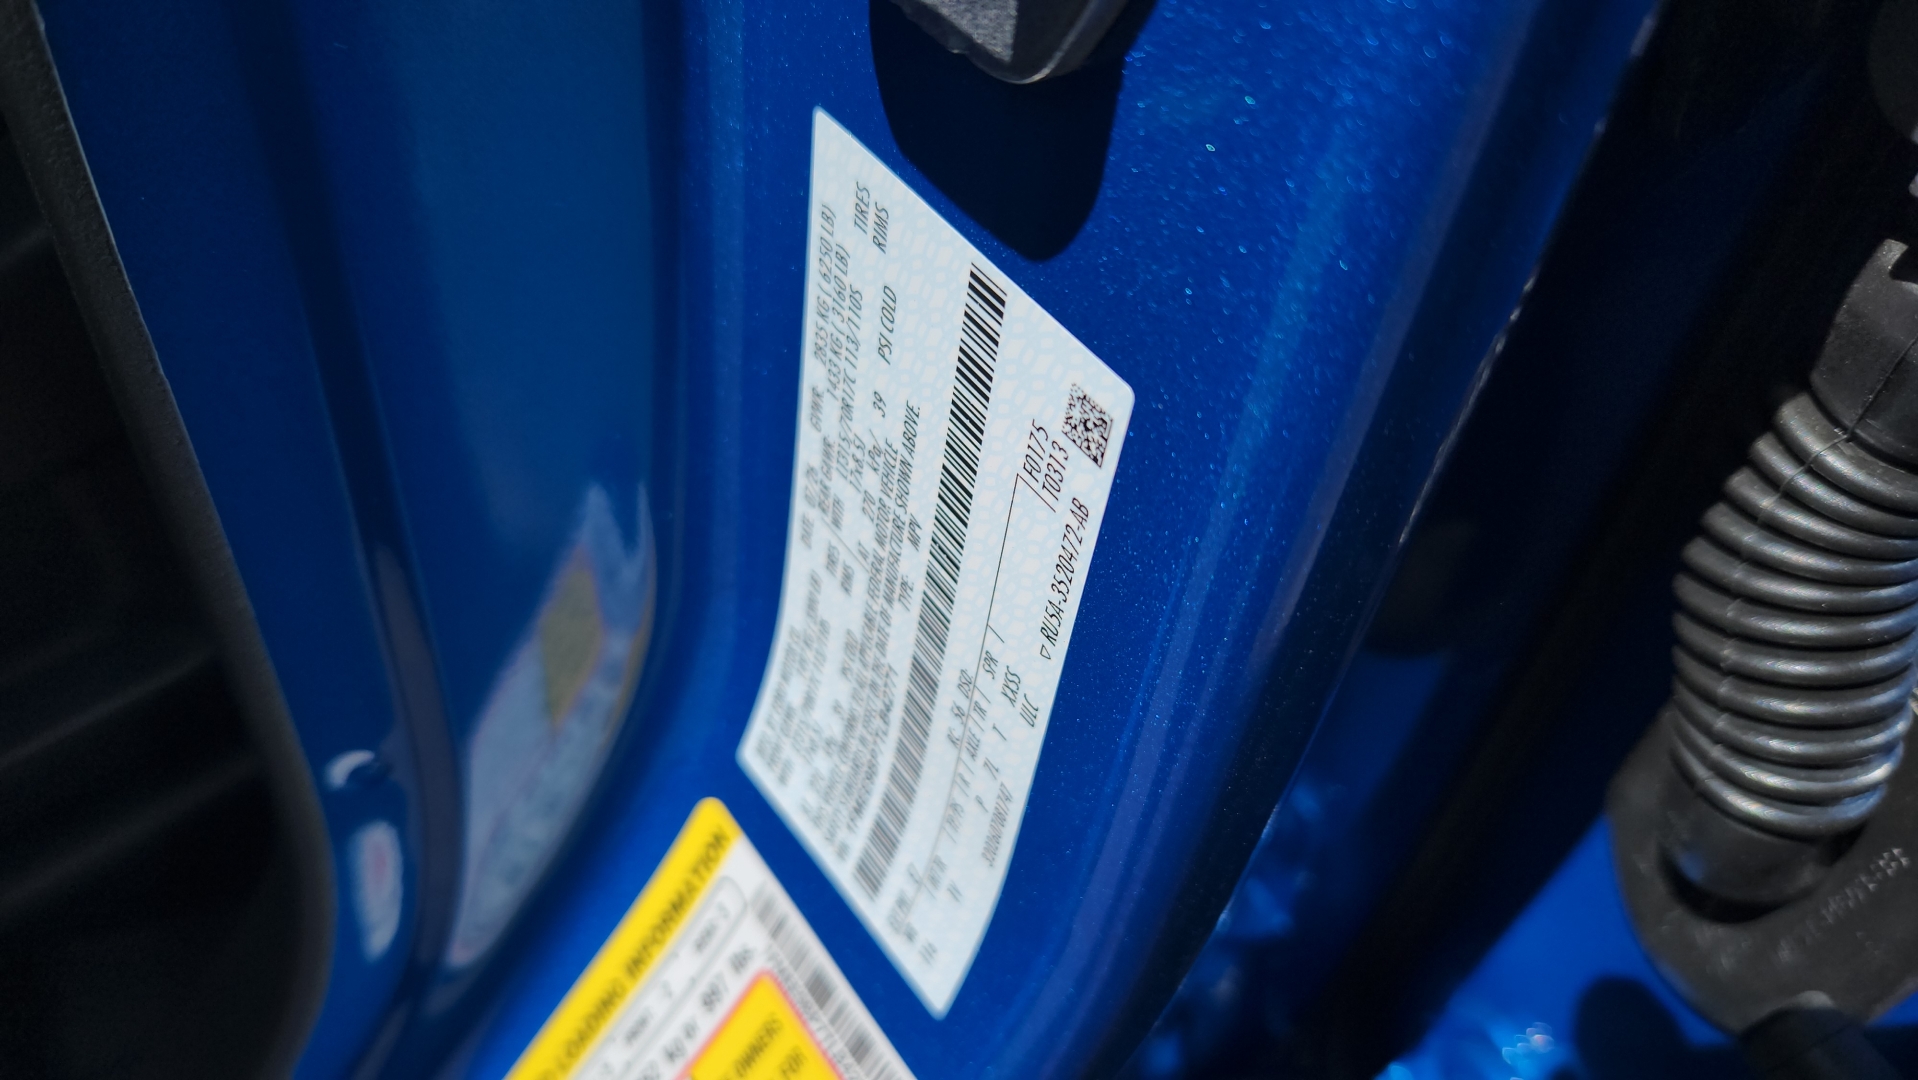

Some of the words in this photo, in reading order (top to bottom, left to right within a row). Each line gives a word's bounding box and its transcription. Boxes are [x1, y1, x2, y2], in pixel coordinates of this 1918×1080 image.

[820, 203, 836, 237] LB)
[853, 181, 870, 234] TIRES
[818, 235, 833, 284] 6250
[834, 243, 850, 276] LB)
[815, 295, 830, 324] KG
[831, 274, 846, 323] 3160
[879, 284, 896, 333] COLD
[813, 321, 828, 366] 2835
[829, 332, 843, 360] KG
[844, 284, 862, 368] 113/110S
[877, 331, 892, 364] PSI
[826, 357, 841, 400] 1433
[840, 561, 854, 595] RIMS
[849, 433, 866, 492] 17x8.5J
[872, 201, 889, 253] RIMS
[809, 386, 823, 432] GVWR:
[835, 368, 856, 479] LT315/70R17C
[872, 390, 886, 418] 39
[901, 400, 920, 458] ABOVE.
[1022, 419, 1048, 482] F0175
[820, 436, 834, 481] GAWR:
[880, 438, 898, 499] VEHICLE
[1041, 440, 1068, 500] T0313
[804, 463, 818, 508] 07/26
[817, 478, 830, 515] REAR
[861, 489, 876, 523] 270
[894, 454, 912, 514] SHOWN
[830, 493, 843, 530] WITH
[874, 497, 890, 550] MOTOR
[825, 542, 839, 576] TIRES
[857, 540, 870, 564] AT
[882, 510, 905, 607] MANUFACTURE
[897, 575, 913, 611] TYPE:
[906, 513, 922, 551] MPV
[867, 549, 884, 602] FEDERAL
[879, 603, 891, 627] OF
[1019, 693, 1039, 727] ULC
[1040, 497, 1088, 645] RU5A-3520472-AB
[842, 628, 859, 663] COLD
[858, 602, 877, 669] APPLICABLE
[874, 622, 889, 657] DATE
[870, 654, 885, 680] THE
[956, 668, 973, 699] DSO:
[950, 702, 966, 725] 56
[964, 727, 980, 761] AXLE
[972, 700, 987, 720] TR
[982, 649, 998, 679] SPR
[982, 757, 999, 780] 7L
[991, 723, 1007, 741] T
[1001, 665, 1021, 707] XXSS
[556, 977, 628, 1072] LOADING
[624, 825, 731, 979] INFORMATION
